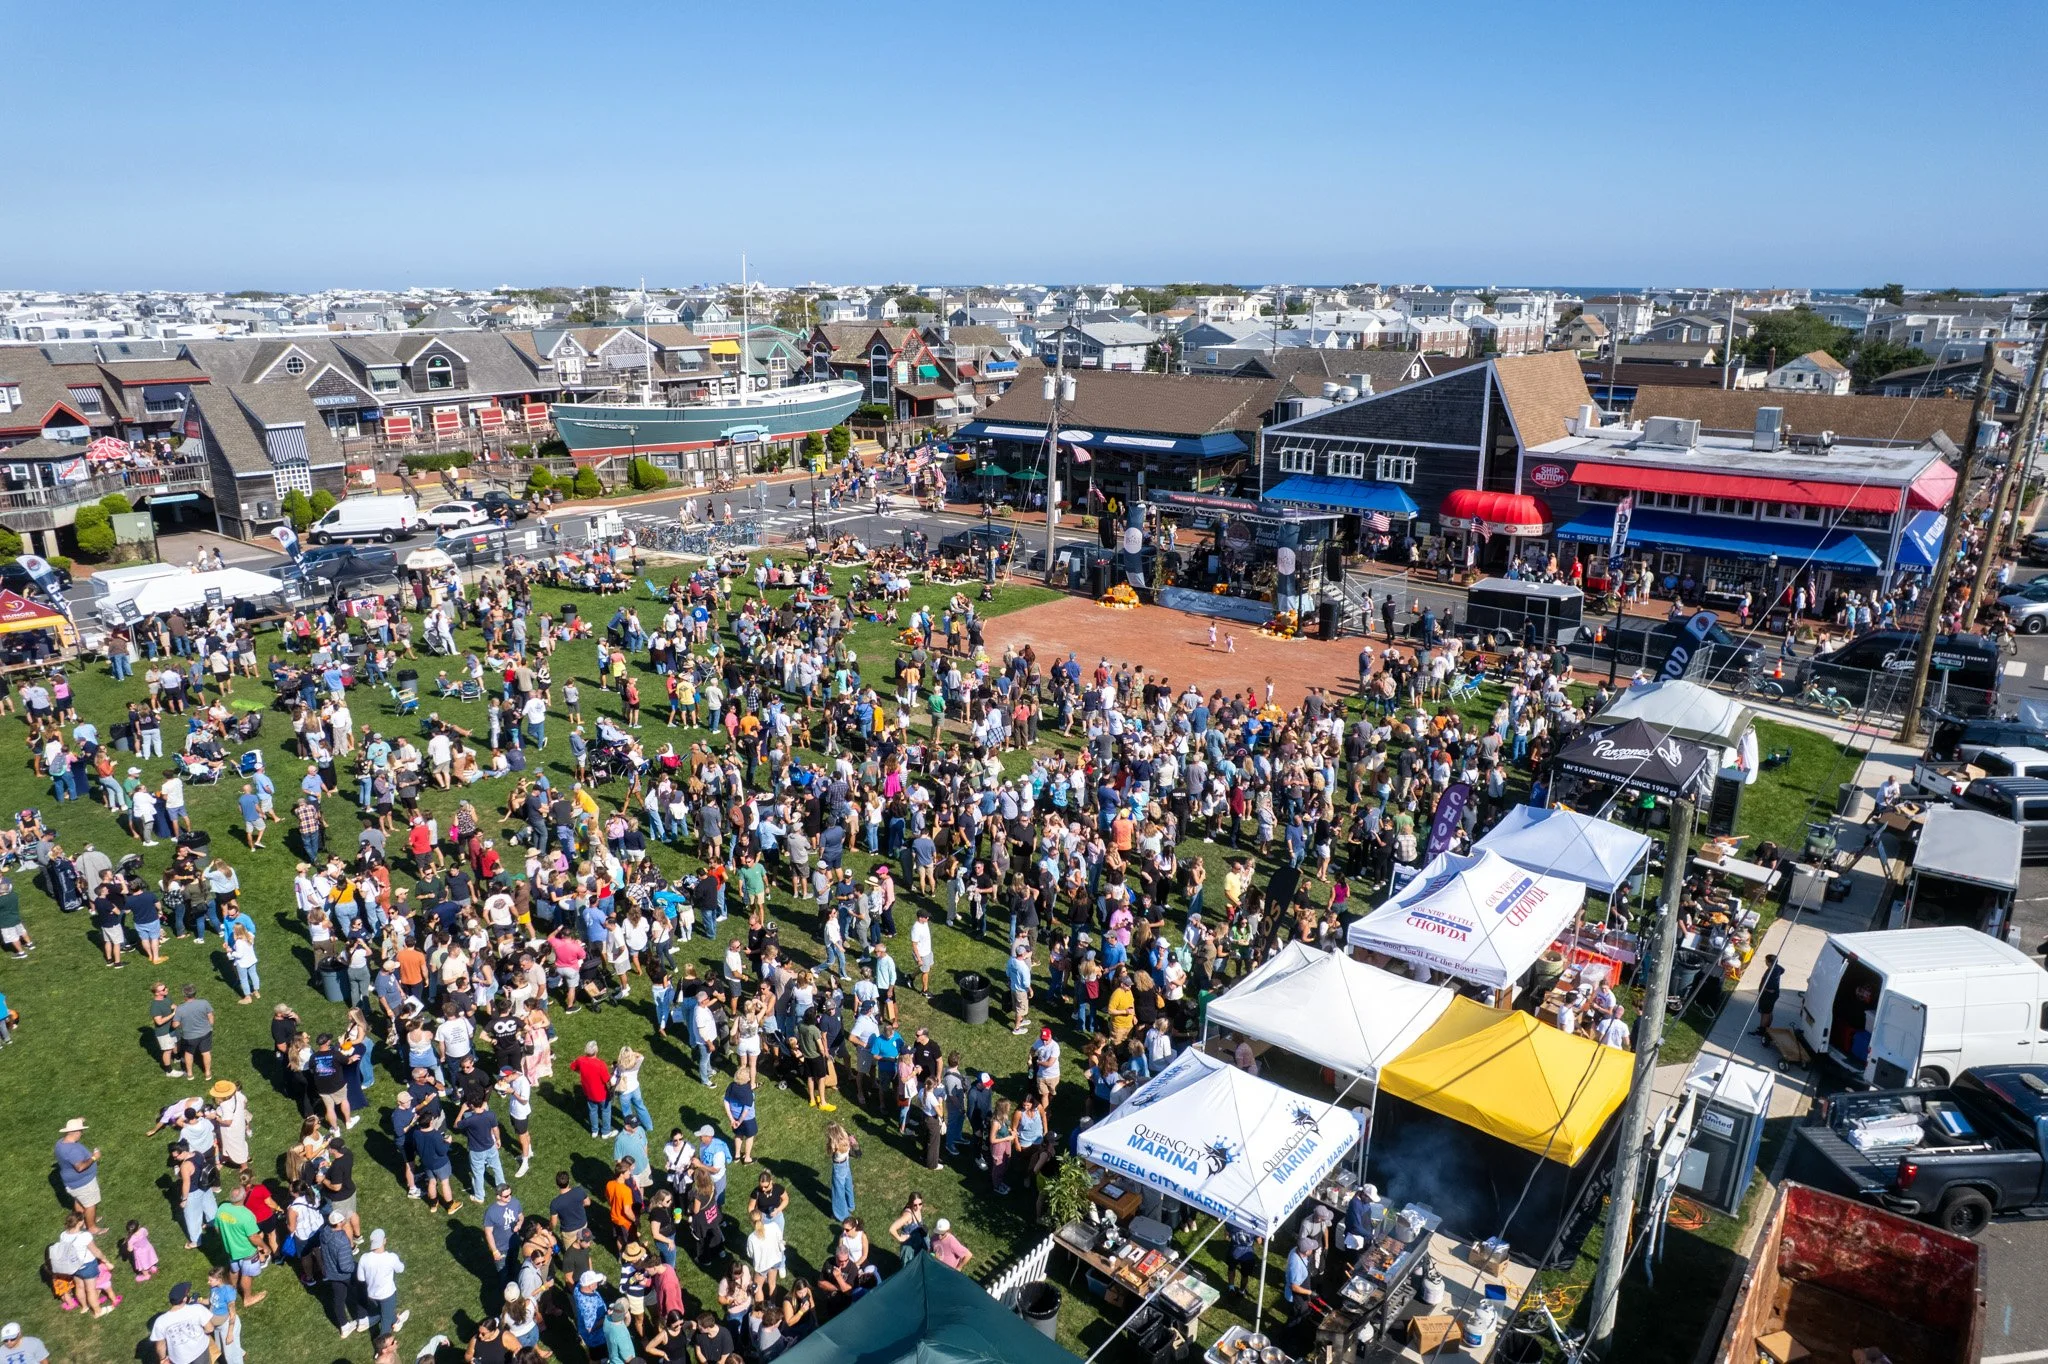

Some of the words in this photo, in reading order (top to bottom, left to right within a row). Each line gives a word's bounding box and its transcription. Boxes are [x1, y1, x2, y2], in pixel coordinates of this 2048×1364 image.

[313, 397, 340, 405] SILVER
[1535, 472, 1564, 482] BOTTOM
[1540, 466, 1560, 475] SHIP
[1358, 508, 1395, 520] SOP
[1576, 534, 1600, 543] SPICE
[1614, 513, 1629, 555] DELI
[1899, 563, 1925, 573] PIZZA
[1660, 646, 1689, 682] OOD
[1563, 763, 1578, 771] LBI'S
[1579, 766, 1611, 780] FAVORITE
[1611, 774, 1630, 785] PIZZA
[1631, 779, 1651, 789] SINCE
[1651, 784, 1669, 793] 1980
[1413, 906, 1446, 917] COUNTRY
[1447, 914, 1475, 927] KETTLE
[1506, 886, 1549, 927] CHOWDA
[1406, 916, 1467, 942] CHOWDA
[1383, 941, 1401, 952] Good
[1404, 944, 1424, 957] You'll
[1425, 952, 1439, 963] Eat
[1440, 956, 1453, 967] the
[1454, 962, 1479, 975] Bowl!
[494, 1019, 517, 1034] OG
[1703, 1115, 1732, 1129] United
[1126, 1134, 1199, 1175] MARINA
[1272, 1137, 1318, 1185] MARINA
[1101, 1152, 1145, 1178] QUEEN
[1149, 1171, 1180, 1193] CITY
[1183, 1187, 1238, 1220] MARINA
[1284, 1183, 1309, 1216] QUEEN
[1309, 1164, 1328, 1186] CITY
[1326, 1134, 1354, 1167] MARINA
